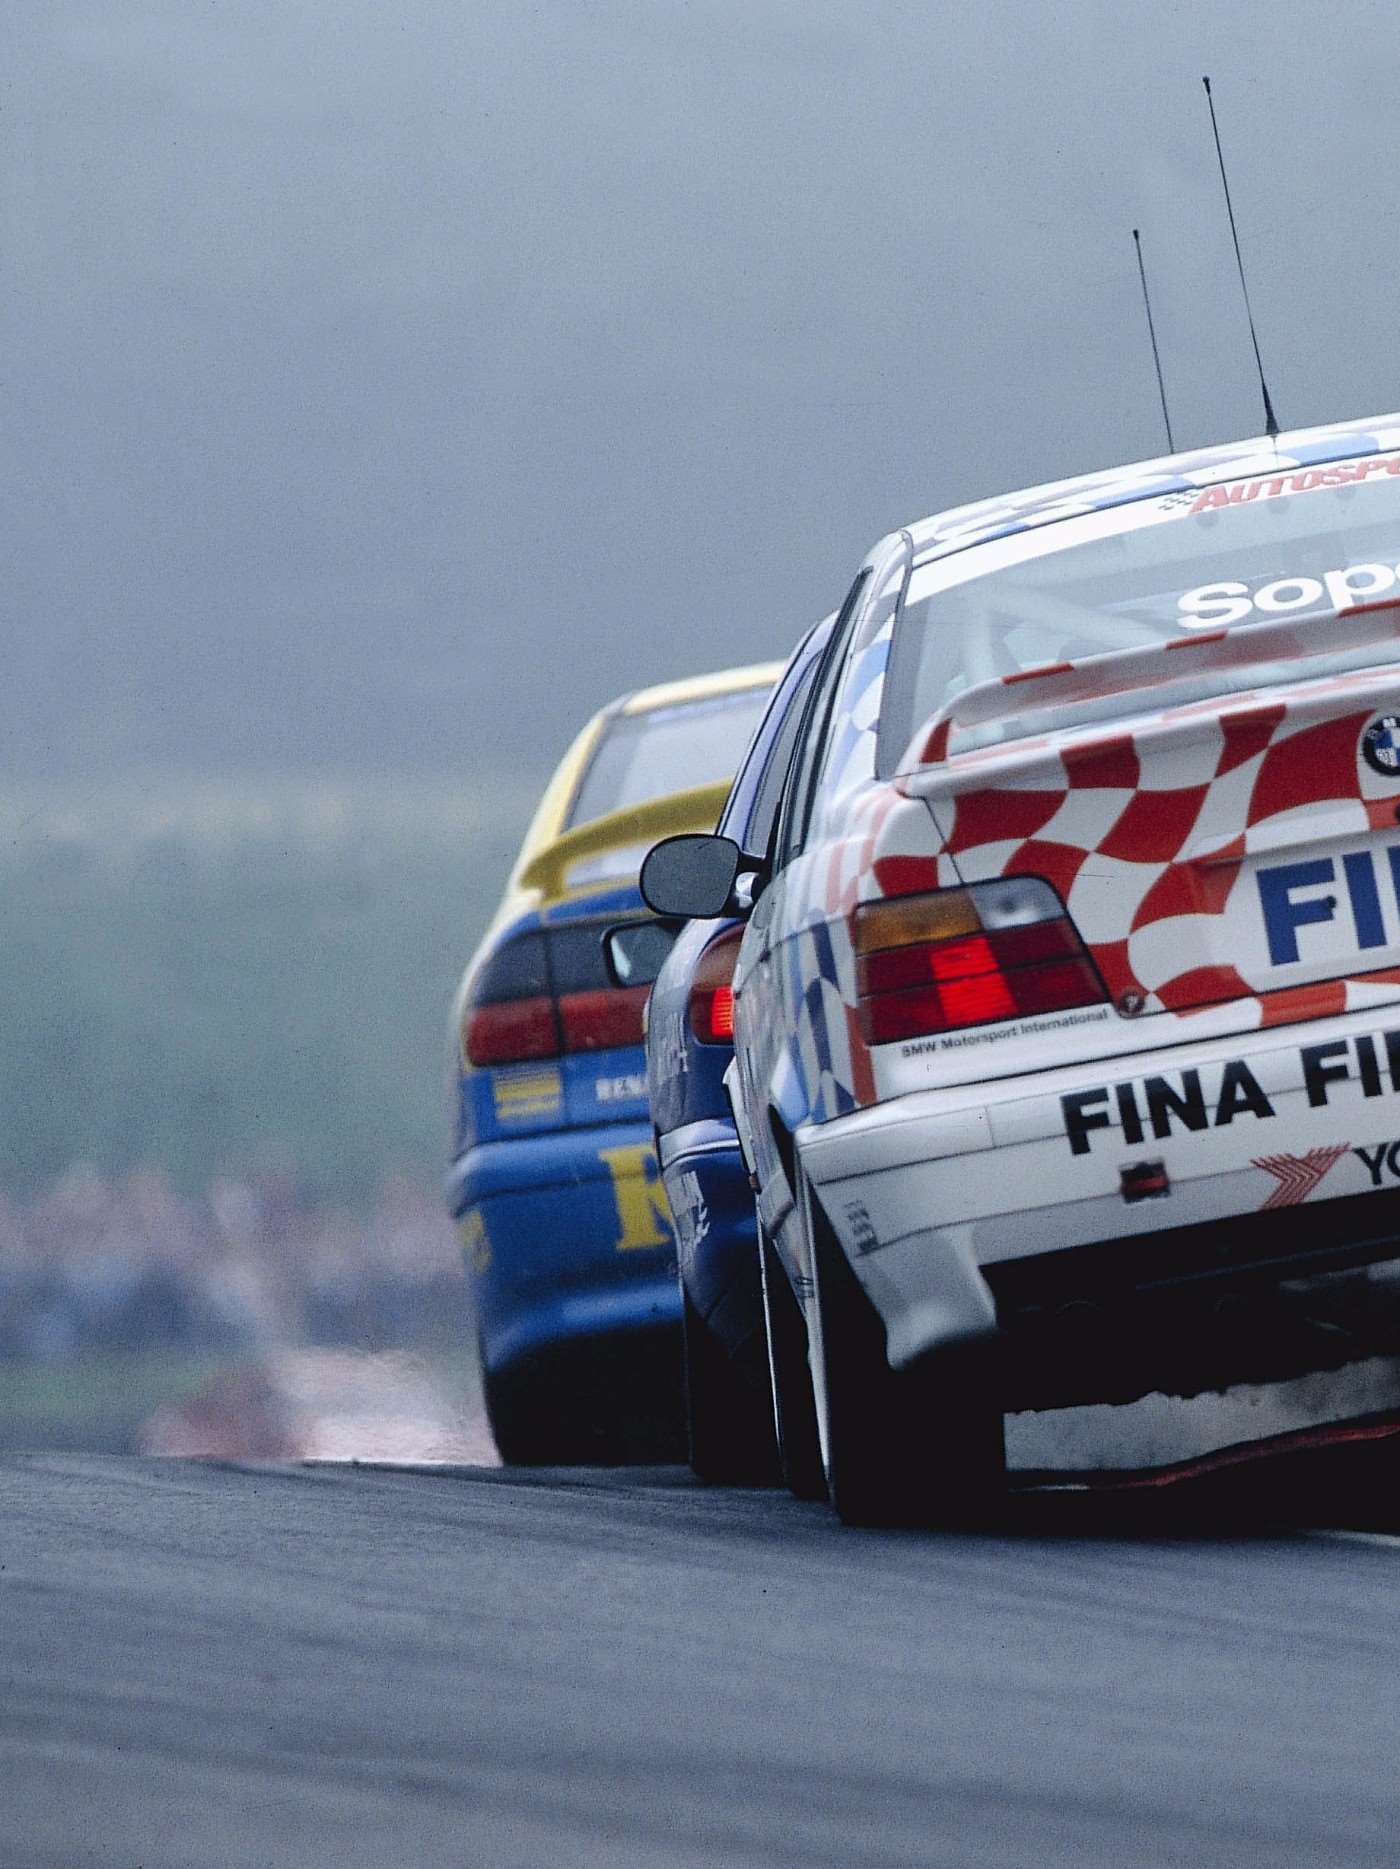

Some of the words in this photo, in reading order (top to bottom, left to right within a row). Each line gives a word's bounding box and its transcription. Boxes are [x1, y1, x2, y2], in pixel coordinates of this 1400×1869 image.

[901, 1040, 937, 1058] BMW
[940, 1027, 1019, 1050] Motorsport
[1020, 1008, 1110, 1035] International
[1060, 1059, 1276, 1156] FINA
